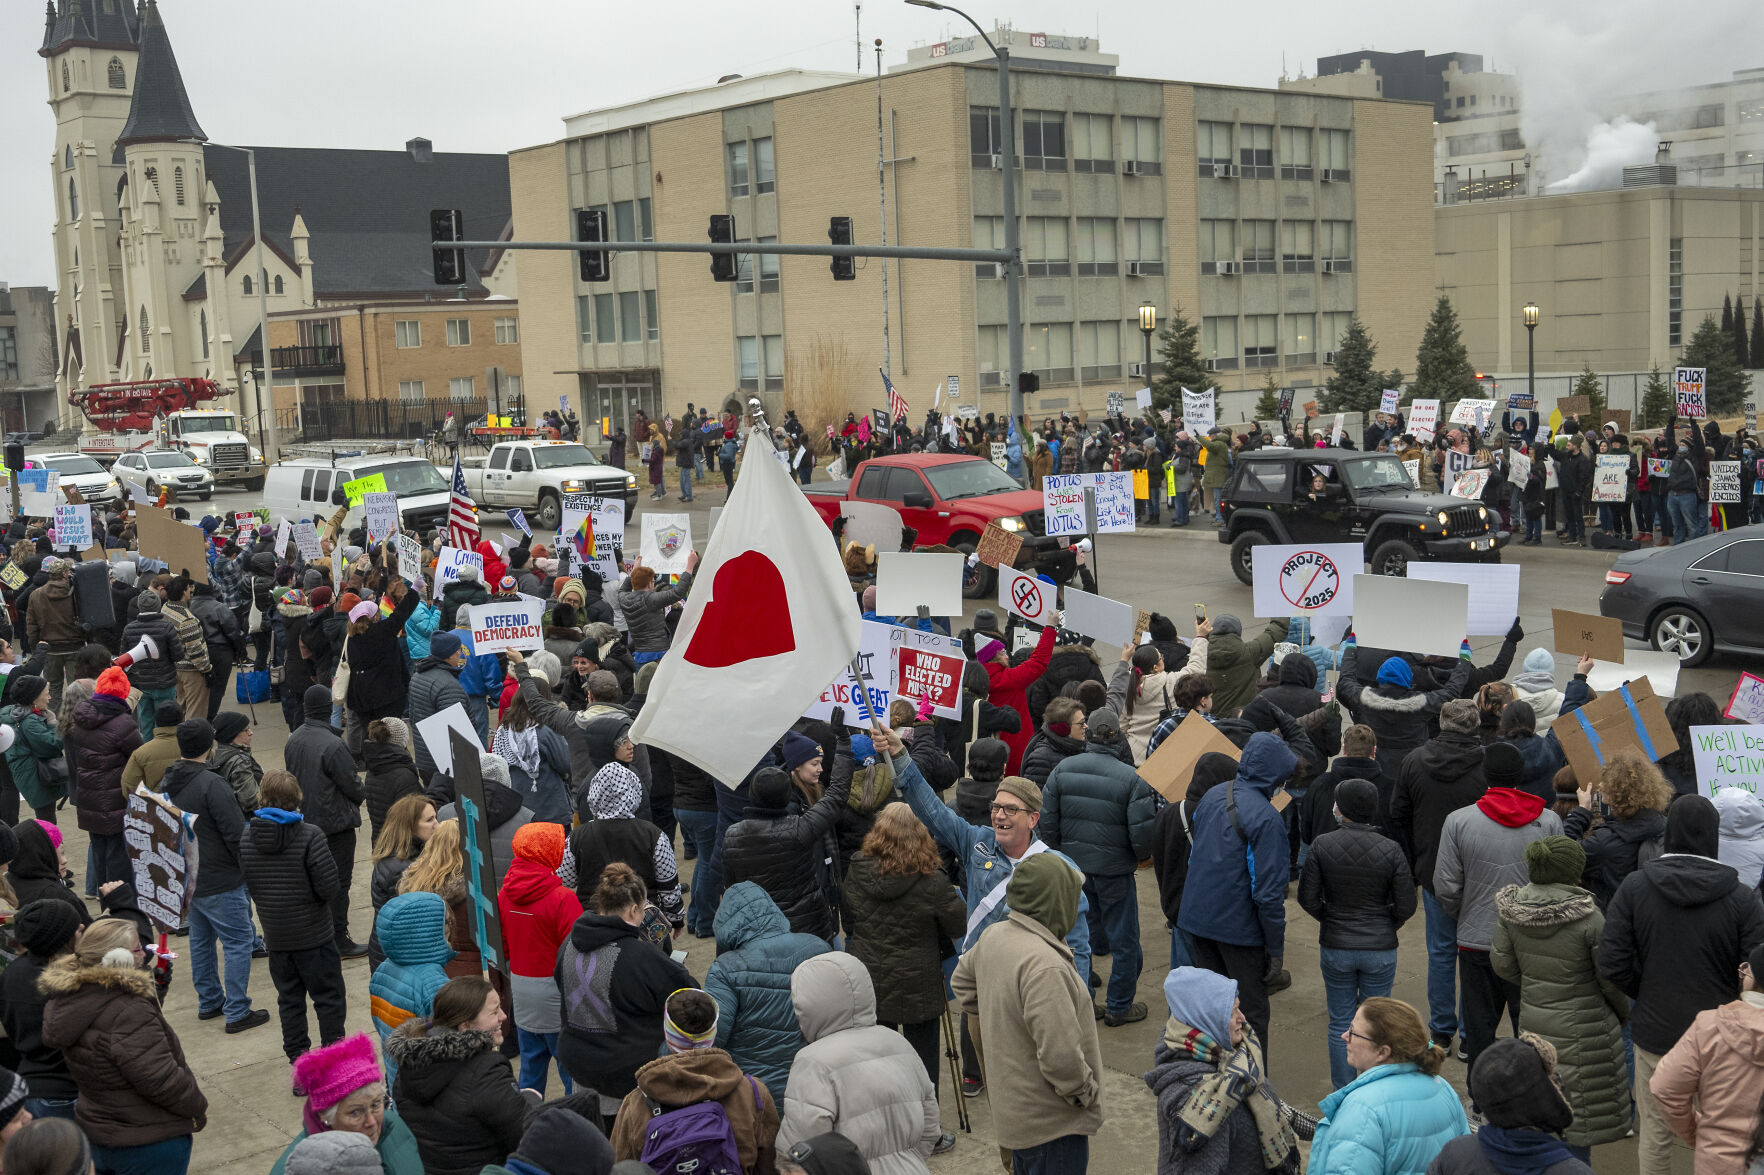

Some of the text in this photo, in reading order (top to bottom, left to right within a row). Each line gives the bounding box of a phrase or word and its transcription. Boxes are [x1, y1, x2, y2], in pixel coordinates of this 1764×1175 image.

[1677, 369, 1704, 383] FUCK
[1675, 382, 1703, 394] TRUMP
[1678, 393, 1703, 405] FUCK
[1676, 403, 1706, 417] RACISTS
[91, 438, 115, 447] INTERSTATE
[1711, 464, 1740, 473] UNIDOS
[1045, 474, 1082, 489] POTUS
[1602, 474, 1618, 482] ARE
[1593, 485, 1624, 499] America
[1712, 483, 1740, 491] SEREMOS
[561, 494, 604, 505] RESPECT MY
[1047, 491, 1084, 506] STOLEN
[1710, 492, 1741, 501] VENCIDOS
[564, 501, 602, 511] EXISTENCE
[1096, 506, 1112, 517] List
[56, 515, 85, 525] WOULD
[374, 518, 387, 528] BUT
[1046, 514, 1083, 535] LOTUS
[57, 525, 86, 535] JESUS
[57, 534, 90, 544] DEPORT
[555, 536, 561, 544] IF
[611, 533, 622, 541] MY
[400, 535, 420, 554] SUPPORT
[591, 563, 601, 571] TO
[1282, 553, 1338, 579] PROJECT
[1304, 587, 1334, 607] 2025
[484, 613, 529, 628] DEFEND
[474, 625, 541, 643] DEMOCRACY
[915, 633, 941, 646] TOO
[1017, 635, 1032, 646] The
[916, 653, 941, 669] WHO
[905, 664, 952, 688] ELECTED
[832, 684, 849, 704] US
[907, 680, 943, 700] MUSK?
[1697, 730, 1764, 752] We'll be
[137, 876, 154, 898] HIS
[138, 898, 180, 929] FRIENDS
